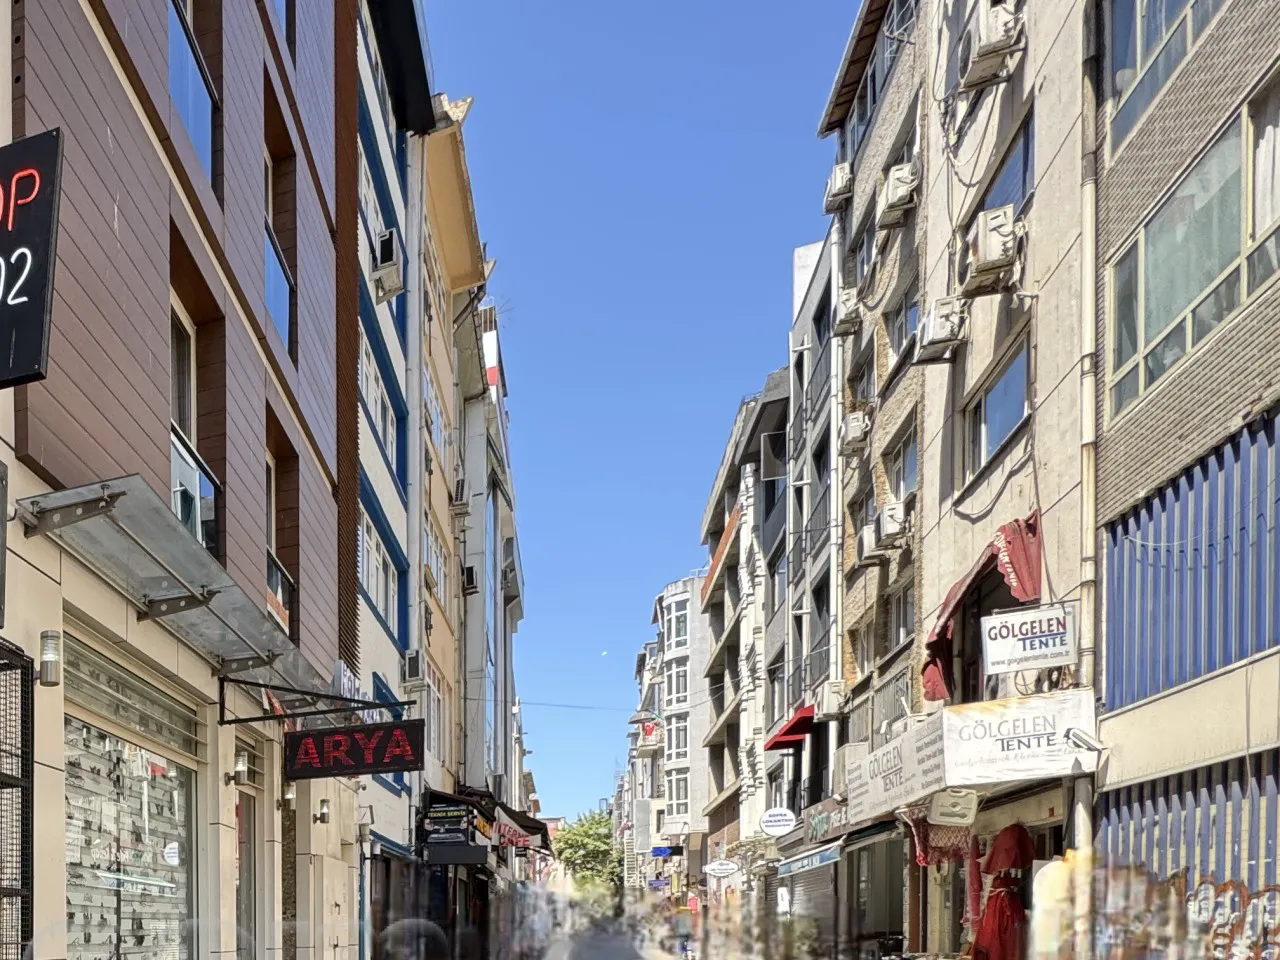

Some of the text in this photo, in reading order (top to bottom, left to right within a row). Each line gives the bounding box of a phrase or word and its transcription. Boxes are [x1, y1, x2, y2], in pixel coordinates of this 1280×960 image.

[987, 615, 1067, 641] GÖLGELEN
[1020, 634, 1068, 652] TENTE
[958, 714, 1057, 742] GÖLGELEN
[294, 728, 416, 770] ARYA
[996, 733, 1057, 752] TENTE
